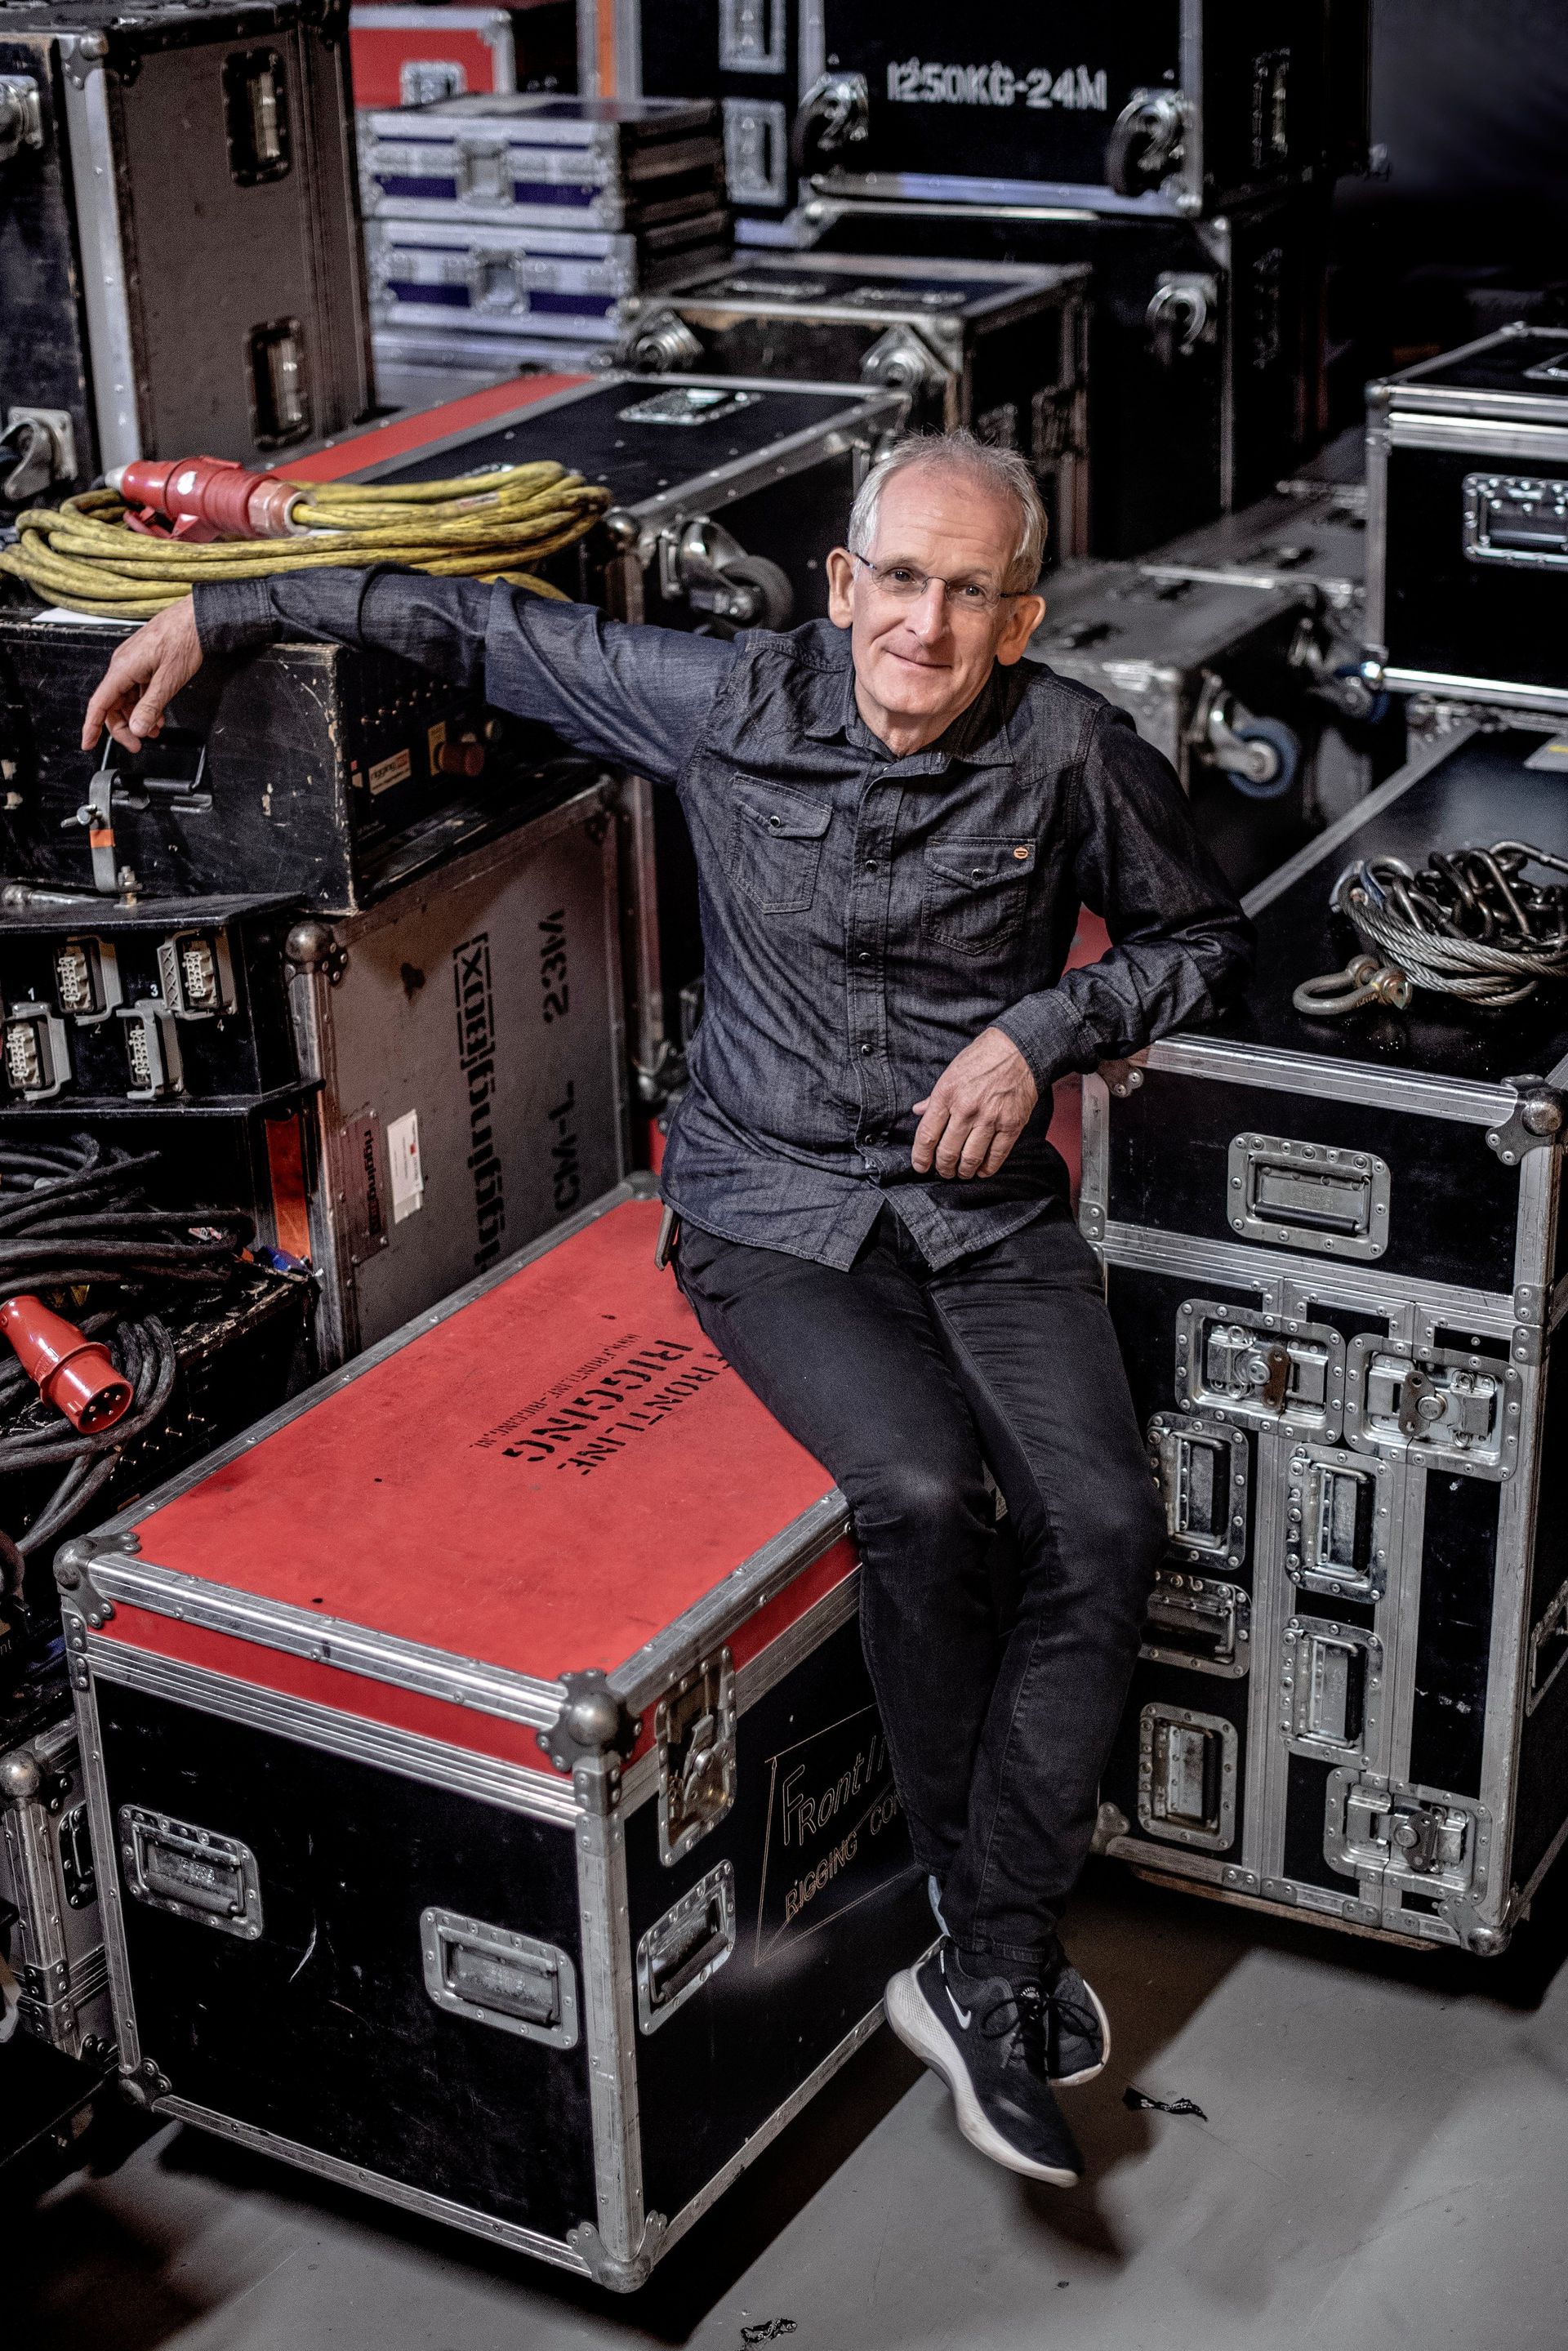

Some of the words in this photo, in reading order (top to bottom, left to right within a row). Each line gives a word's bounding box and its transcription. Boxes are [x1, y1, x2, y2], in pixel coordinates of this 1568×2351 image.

[887, 56, 1107, 111] 1250KG-24M
[28, 986, 35, 1001] 1
[150, 984, 158, 997] 3
[94, 1022, 101, 1034] 2
[216, 1019, 225, 1032] 4
[501, 1339, 693, 1462] RIGGING
[786, 1830, 858, 1921] RIGGING
